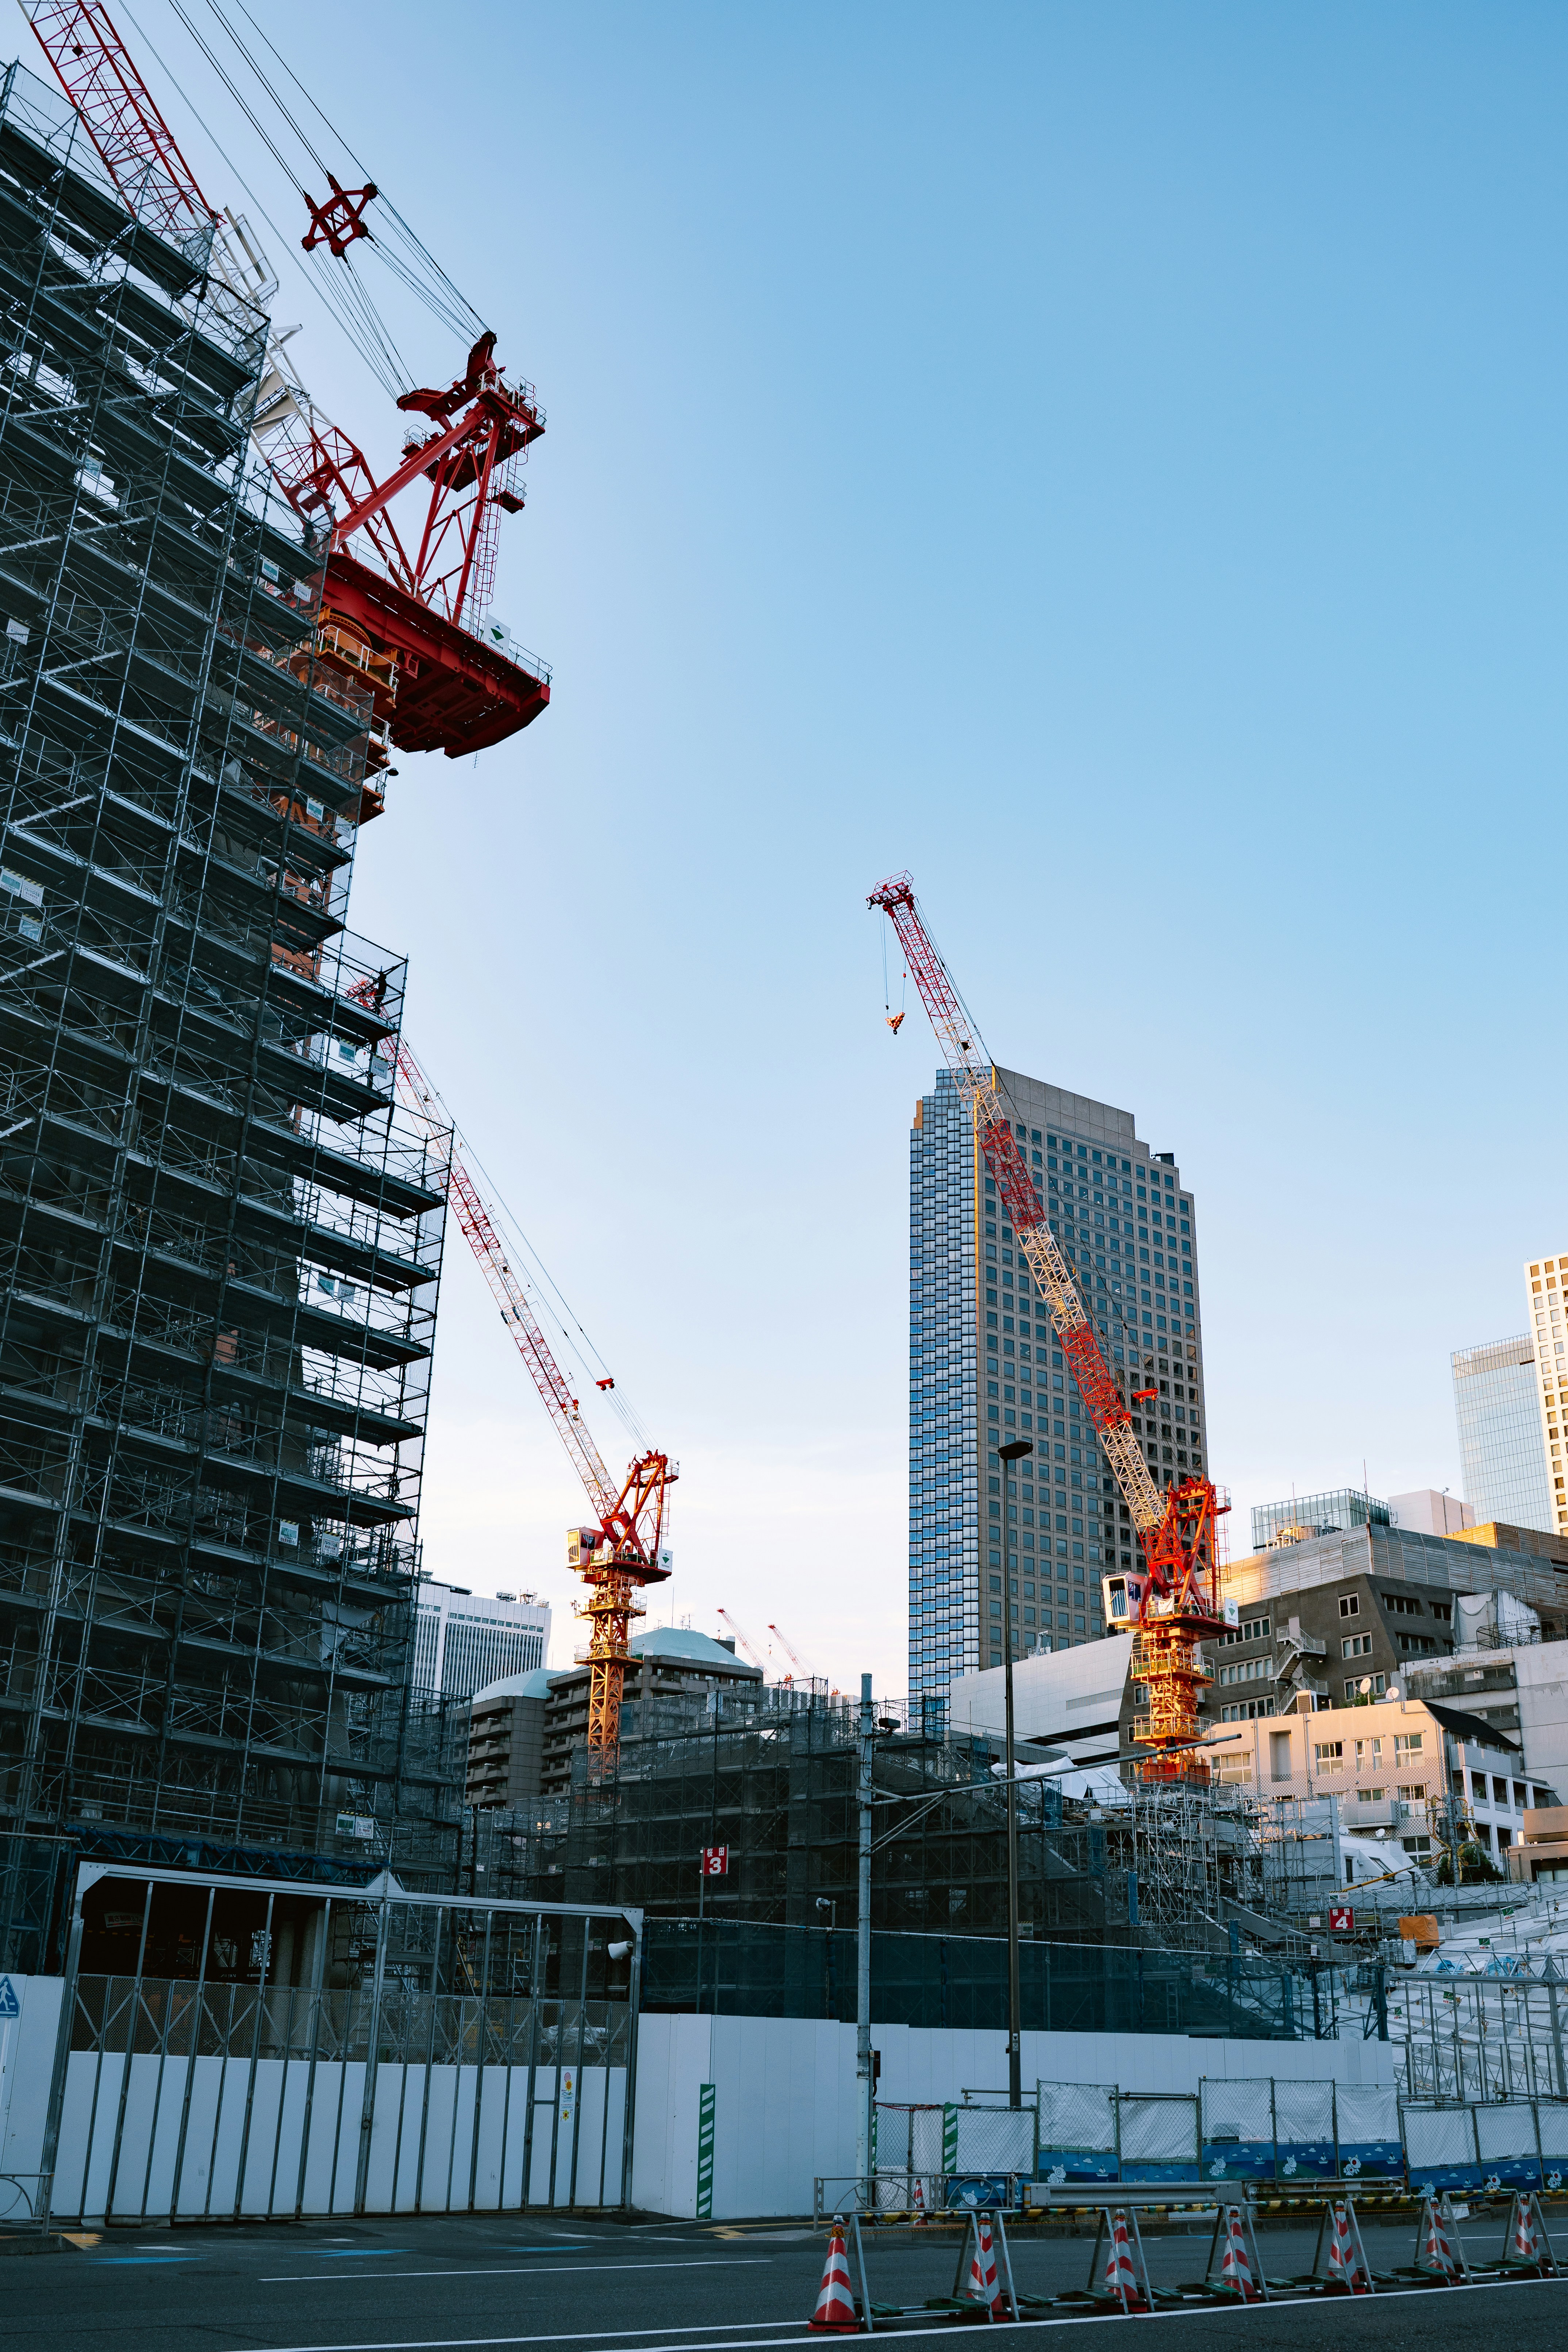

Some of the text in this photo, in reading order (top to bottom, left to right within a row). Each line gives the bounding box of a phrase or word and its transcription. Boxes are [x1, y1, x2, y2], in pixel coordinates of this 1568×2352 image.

[488, 638, 503, 650] OBAYASHI
[709, 1857, 722, 1874] 3
[1336, 1916, 1348, 1929] 4
